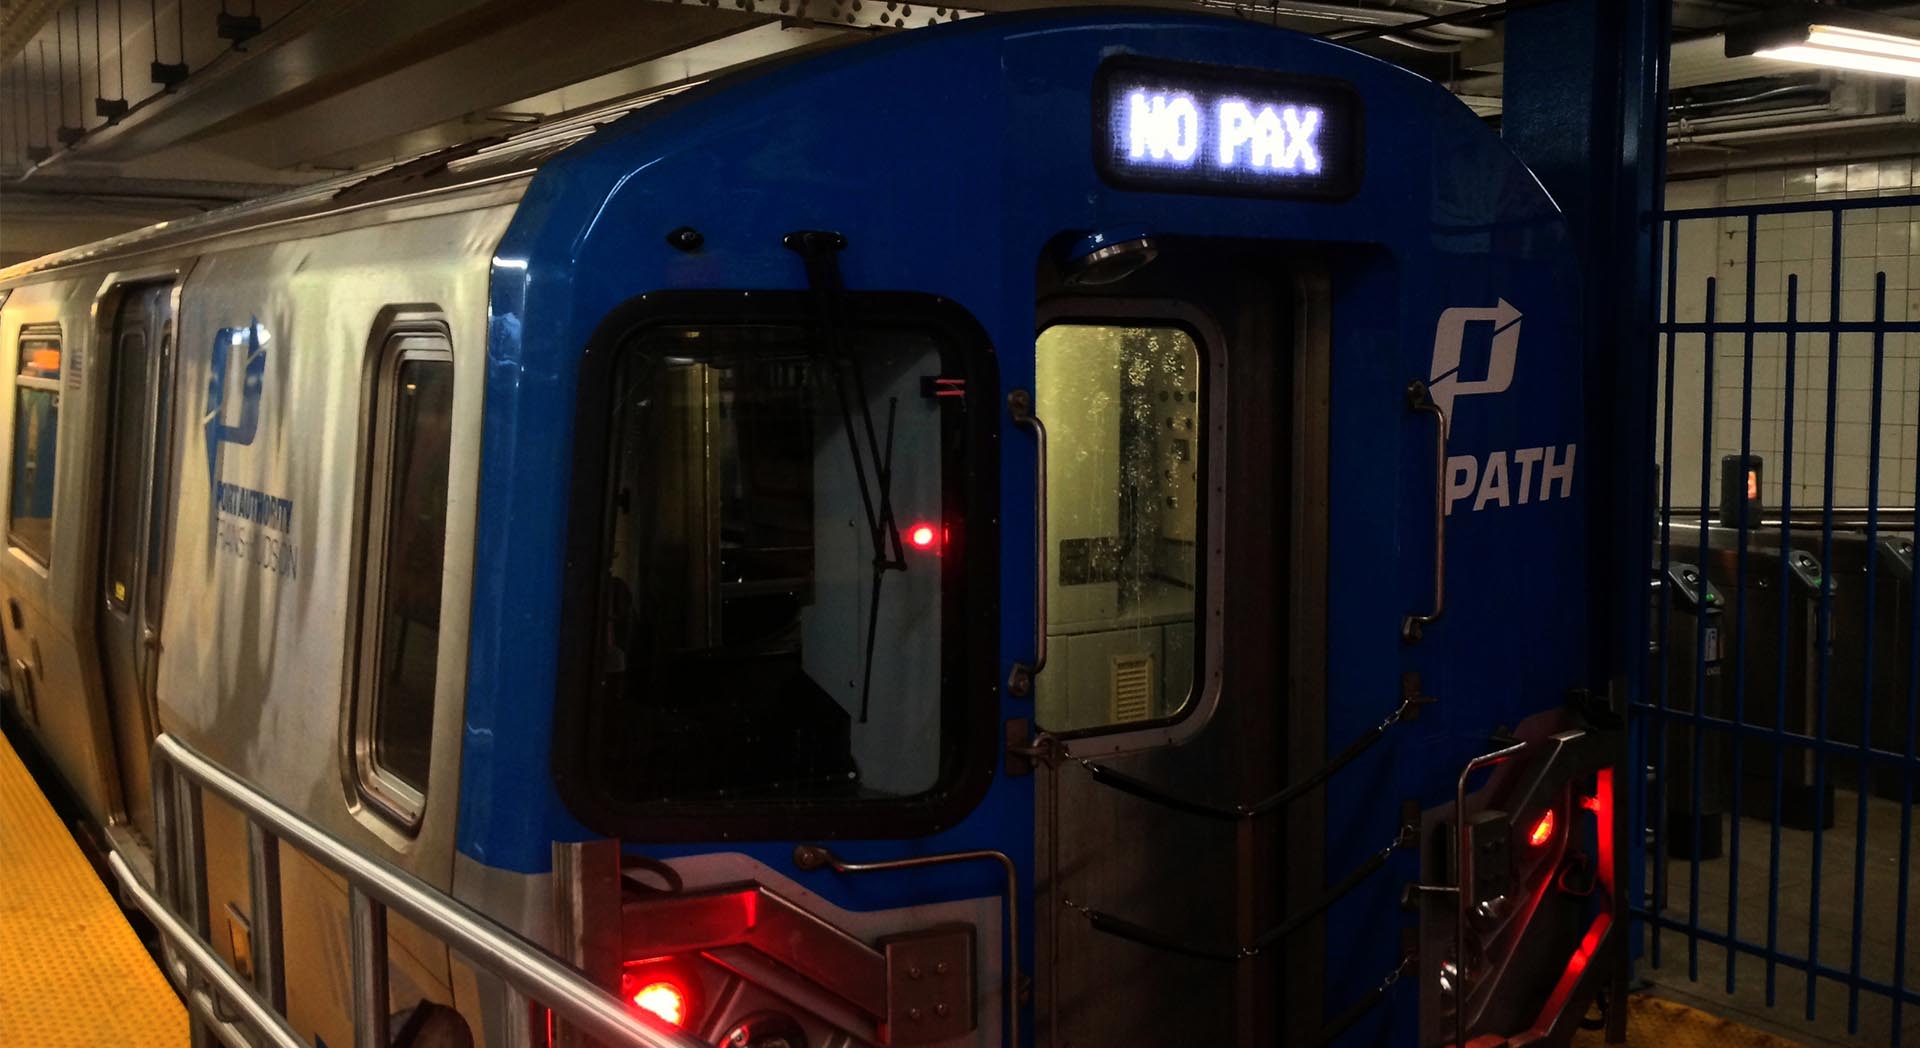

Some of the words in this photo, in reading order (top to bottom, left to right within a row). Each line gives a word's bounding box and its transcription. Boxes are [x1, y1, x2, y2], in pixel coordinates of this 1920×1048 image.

[1130, 92, 1198, 162] NO
[1219, 101, 1319, 170] PAX
[1444, 443, 1577, 516] PATH
